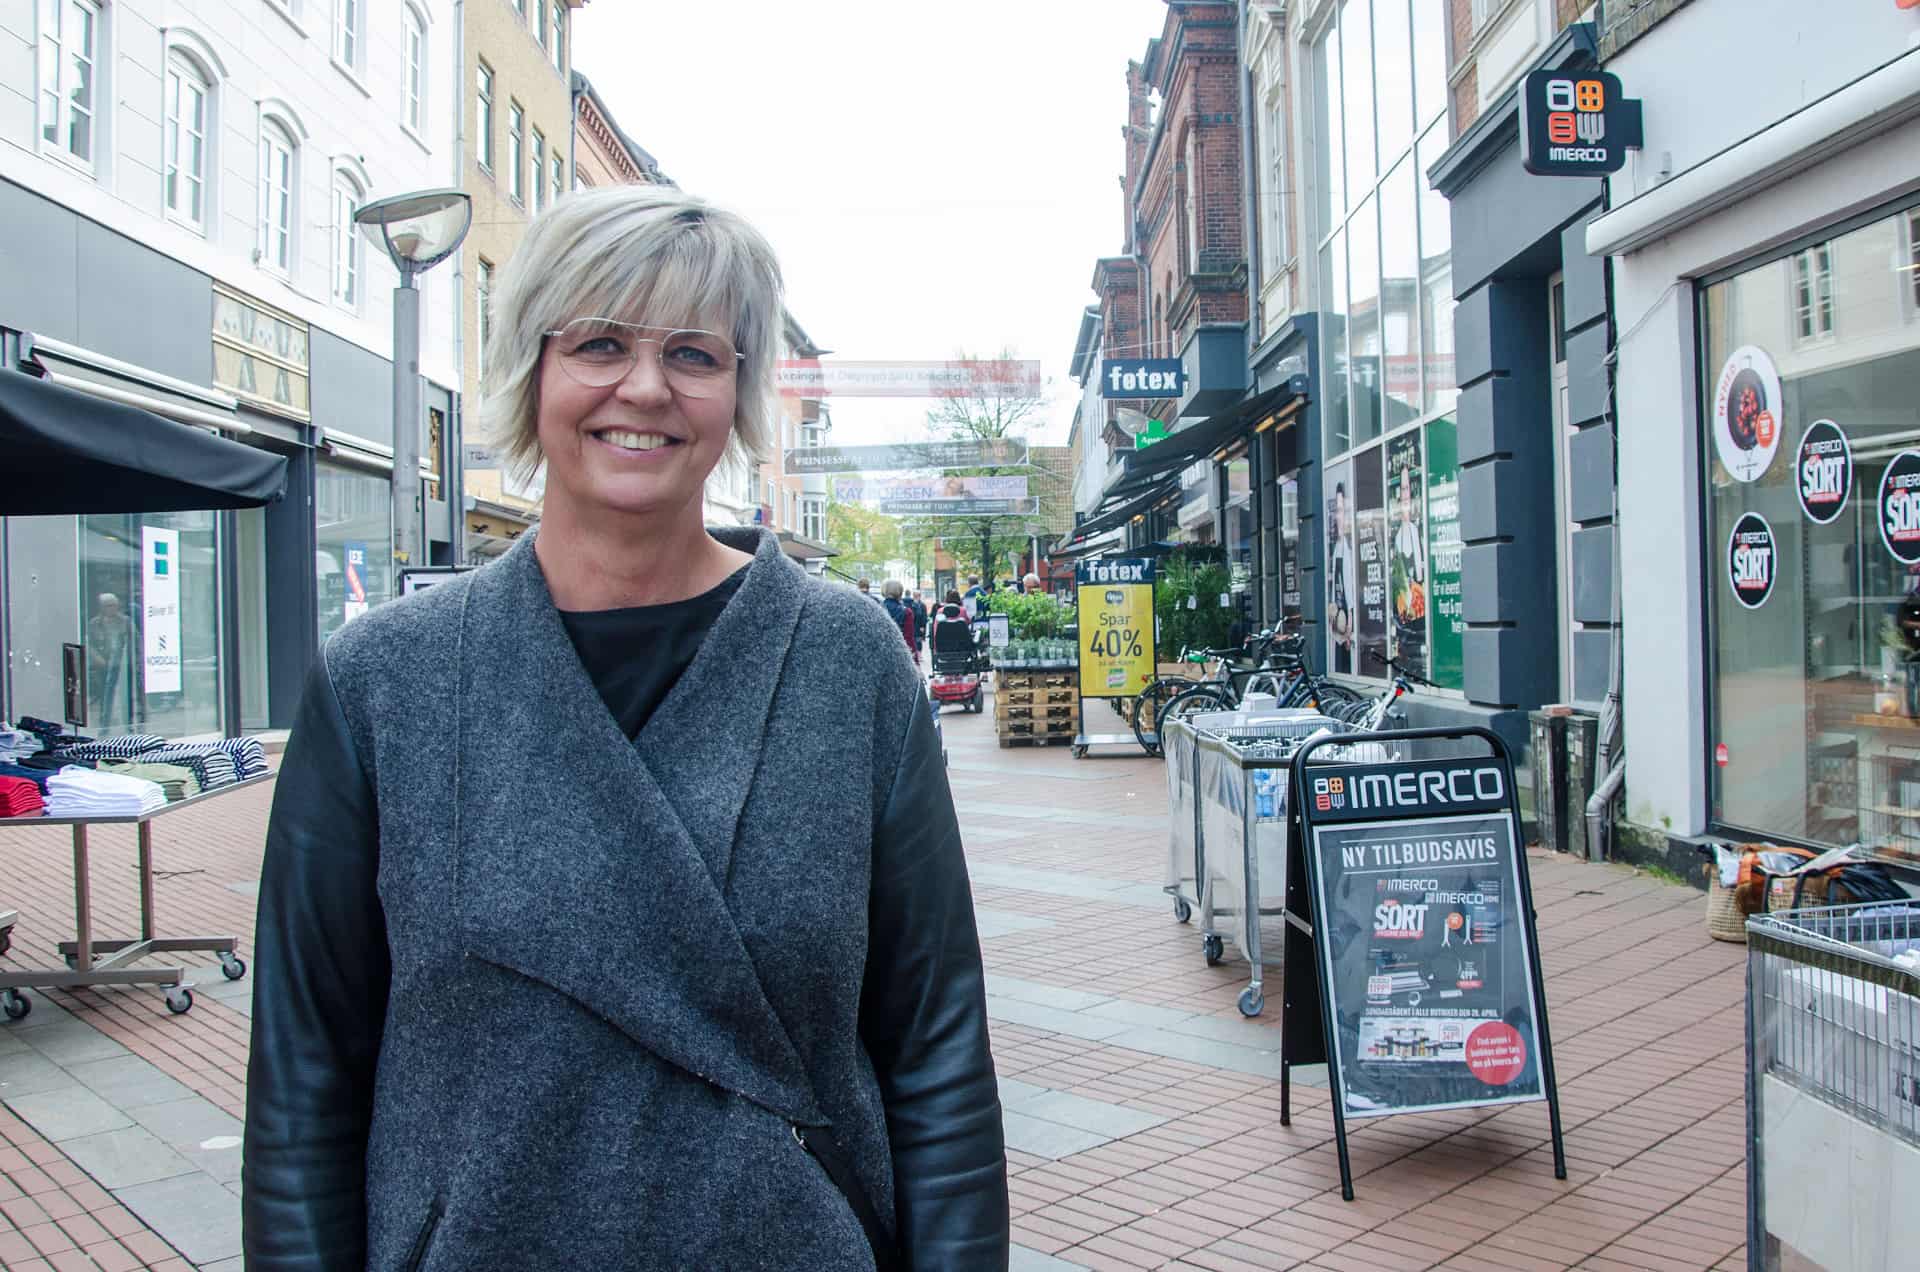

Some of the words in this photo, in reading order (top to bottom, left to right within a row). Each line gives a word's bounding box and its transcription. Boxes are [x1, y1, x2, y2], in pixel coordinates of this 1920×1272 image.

[1549, 147, 1607, 162] IMERCO
[1803, 456, 1845, 498] SORT
[1734, 547, 1771, 584] SORT
[1099, 612, 1132, 628] Spar
[1090, 629, 1142, 657] 40%
[1349, 767, 1504, 809] IMERCO
[1342, 846, 1367, 868] NY
[1371, 837, 1497, 866] TILBUDSAVIS
[1387, 879, 1438, 891] IMERCO
[1435, 893, 1484, 905] IMERCO
[1374, 903, 1429, 930] SORT
